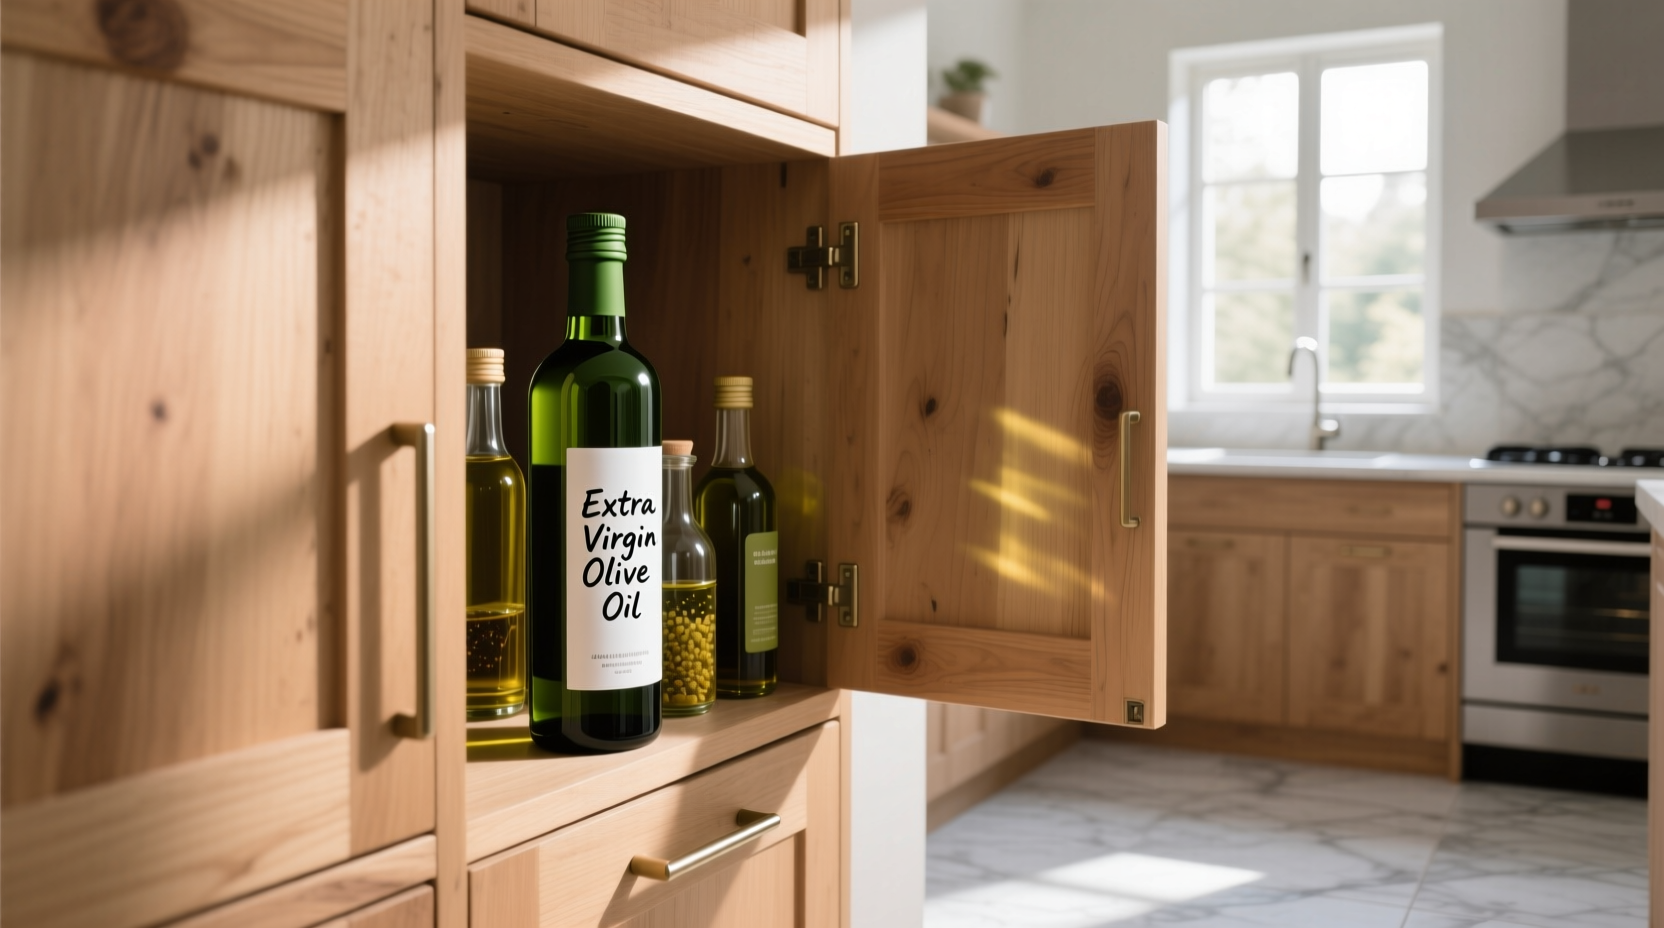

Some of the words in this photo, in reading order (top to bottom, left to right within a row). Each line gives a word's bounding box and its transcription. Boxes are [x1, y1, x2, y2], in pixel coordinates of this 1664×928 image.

[582, 488, 656, 518] Extra
[583, 523, 656, 562] Virgin
[582, 556, 650, 588] Olive
[602, 590, 642, 622] Oil
